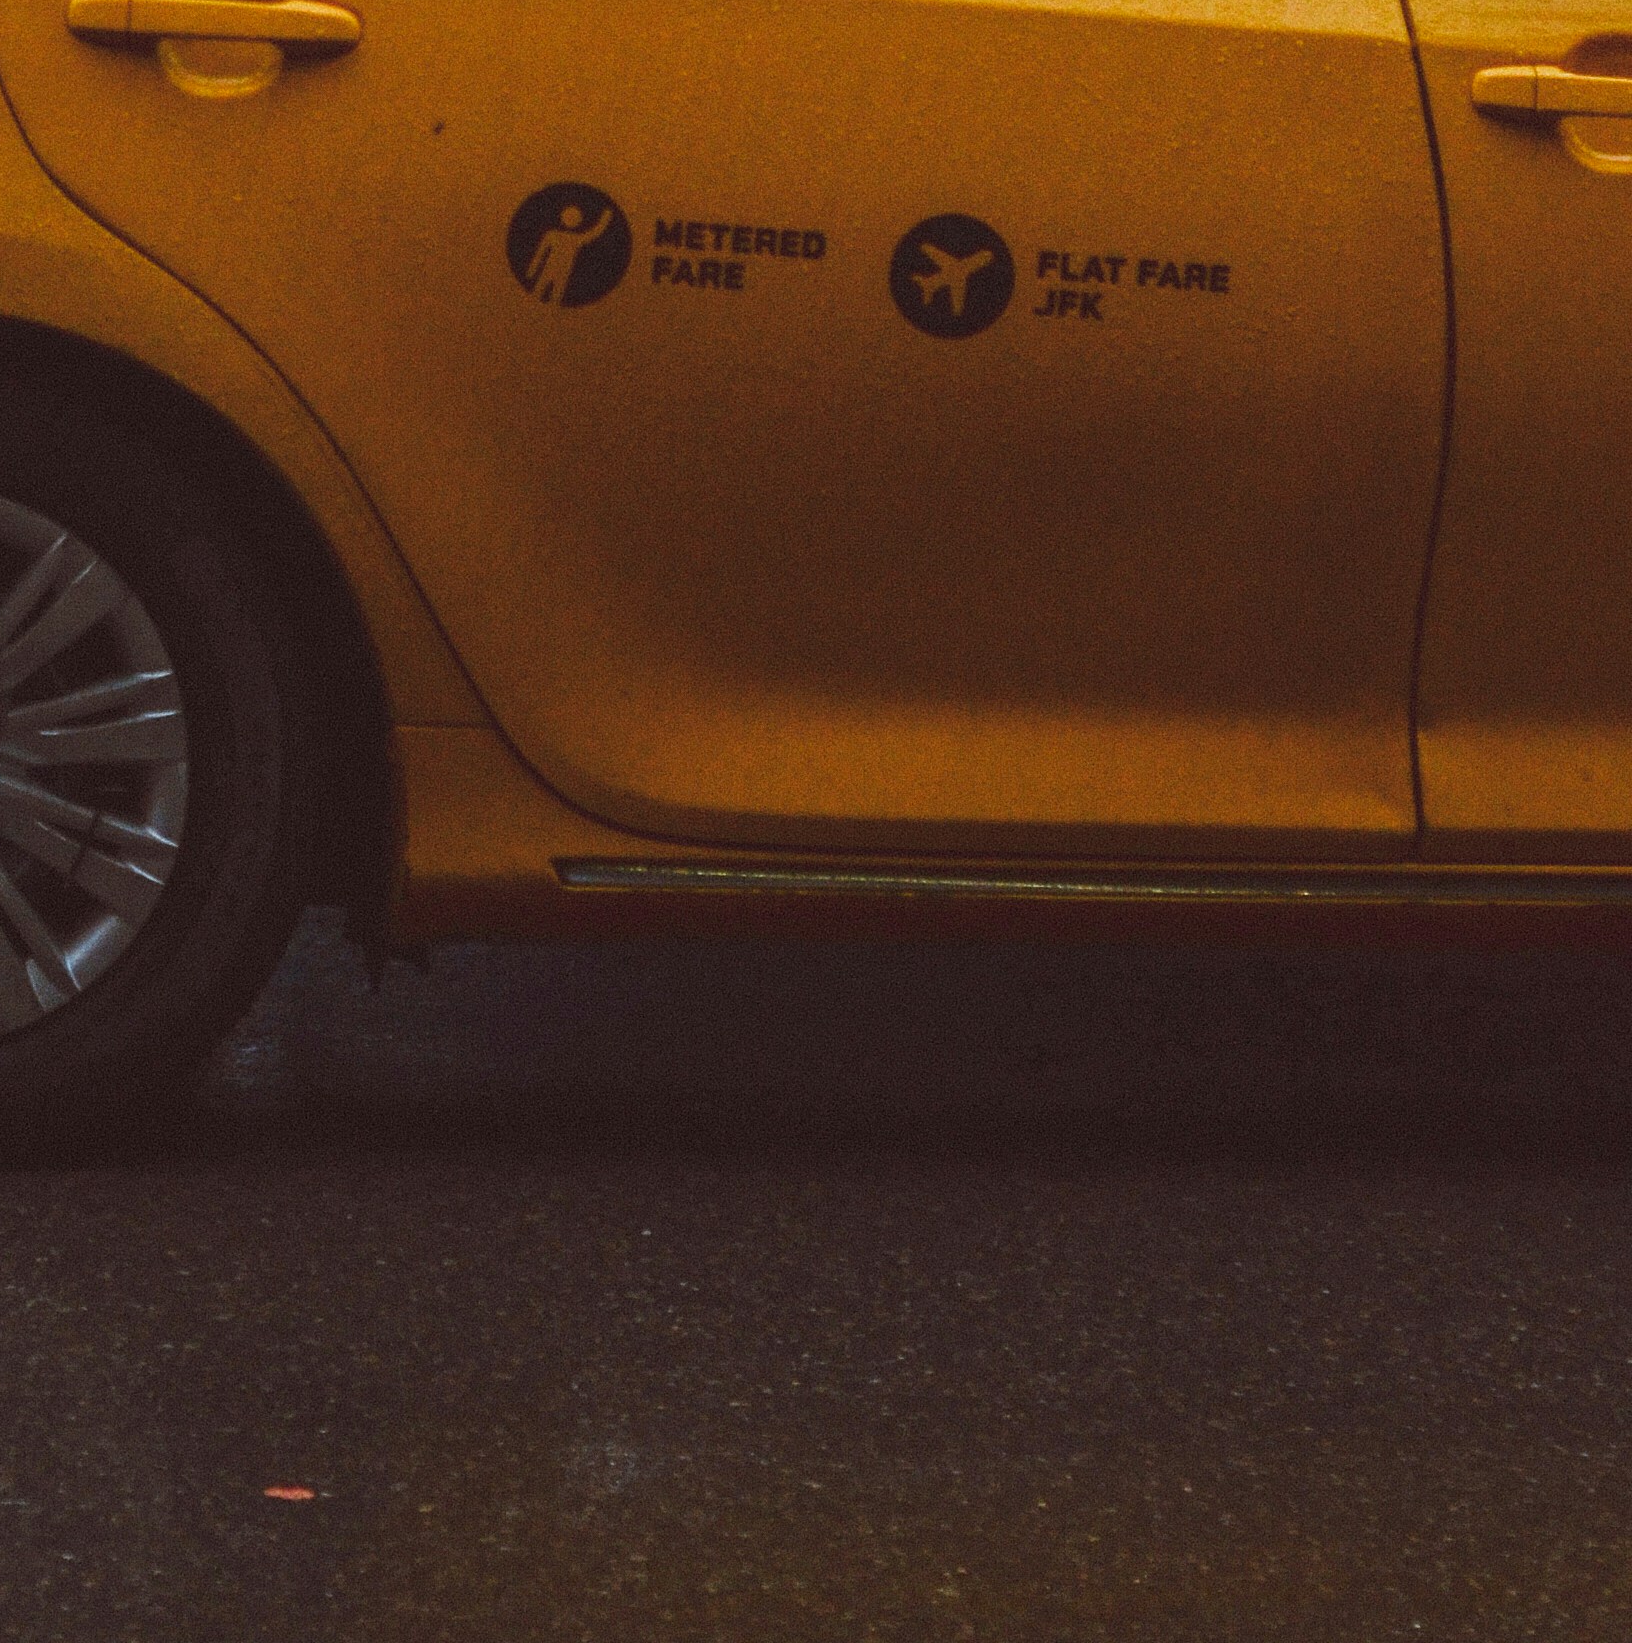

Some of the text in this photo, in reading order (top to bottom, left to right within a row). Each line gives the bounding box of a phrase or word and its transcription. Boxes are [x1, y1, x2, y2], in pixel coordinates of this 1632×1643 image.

[654, 218, 827, 260] METERED
[651, 255, 745, 290] FARE
[1035, 250, 1231, 294] FLAT FARE
[1033, 289, 1105, 322] JFK
